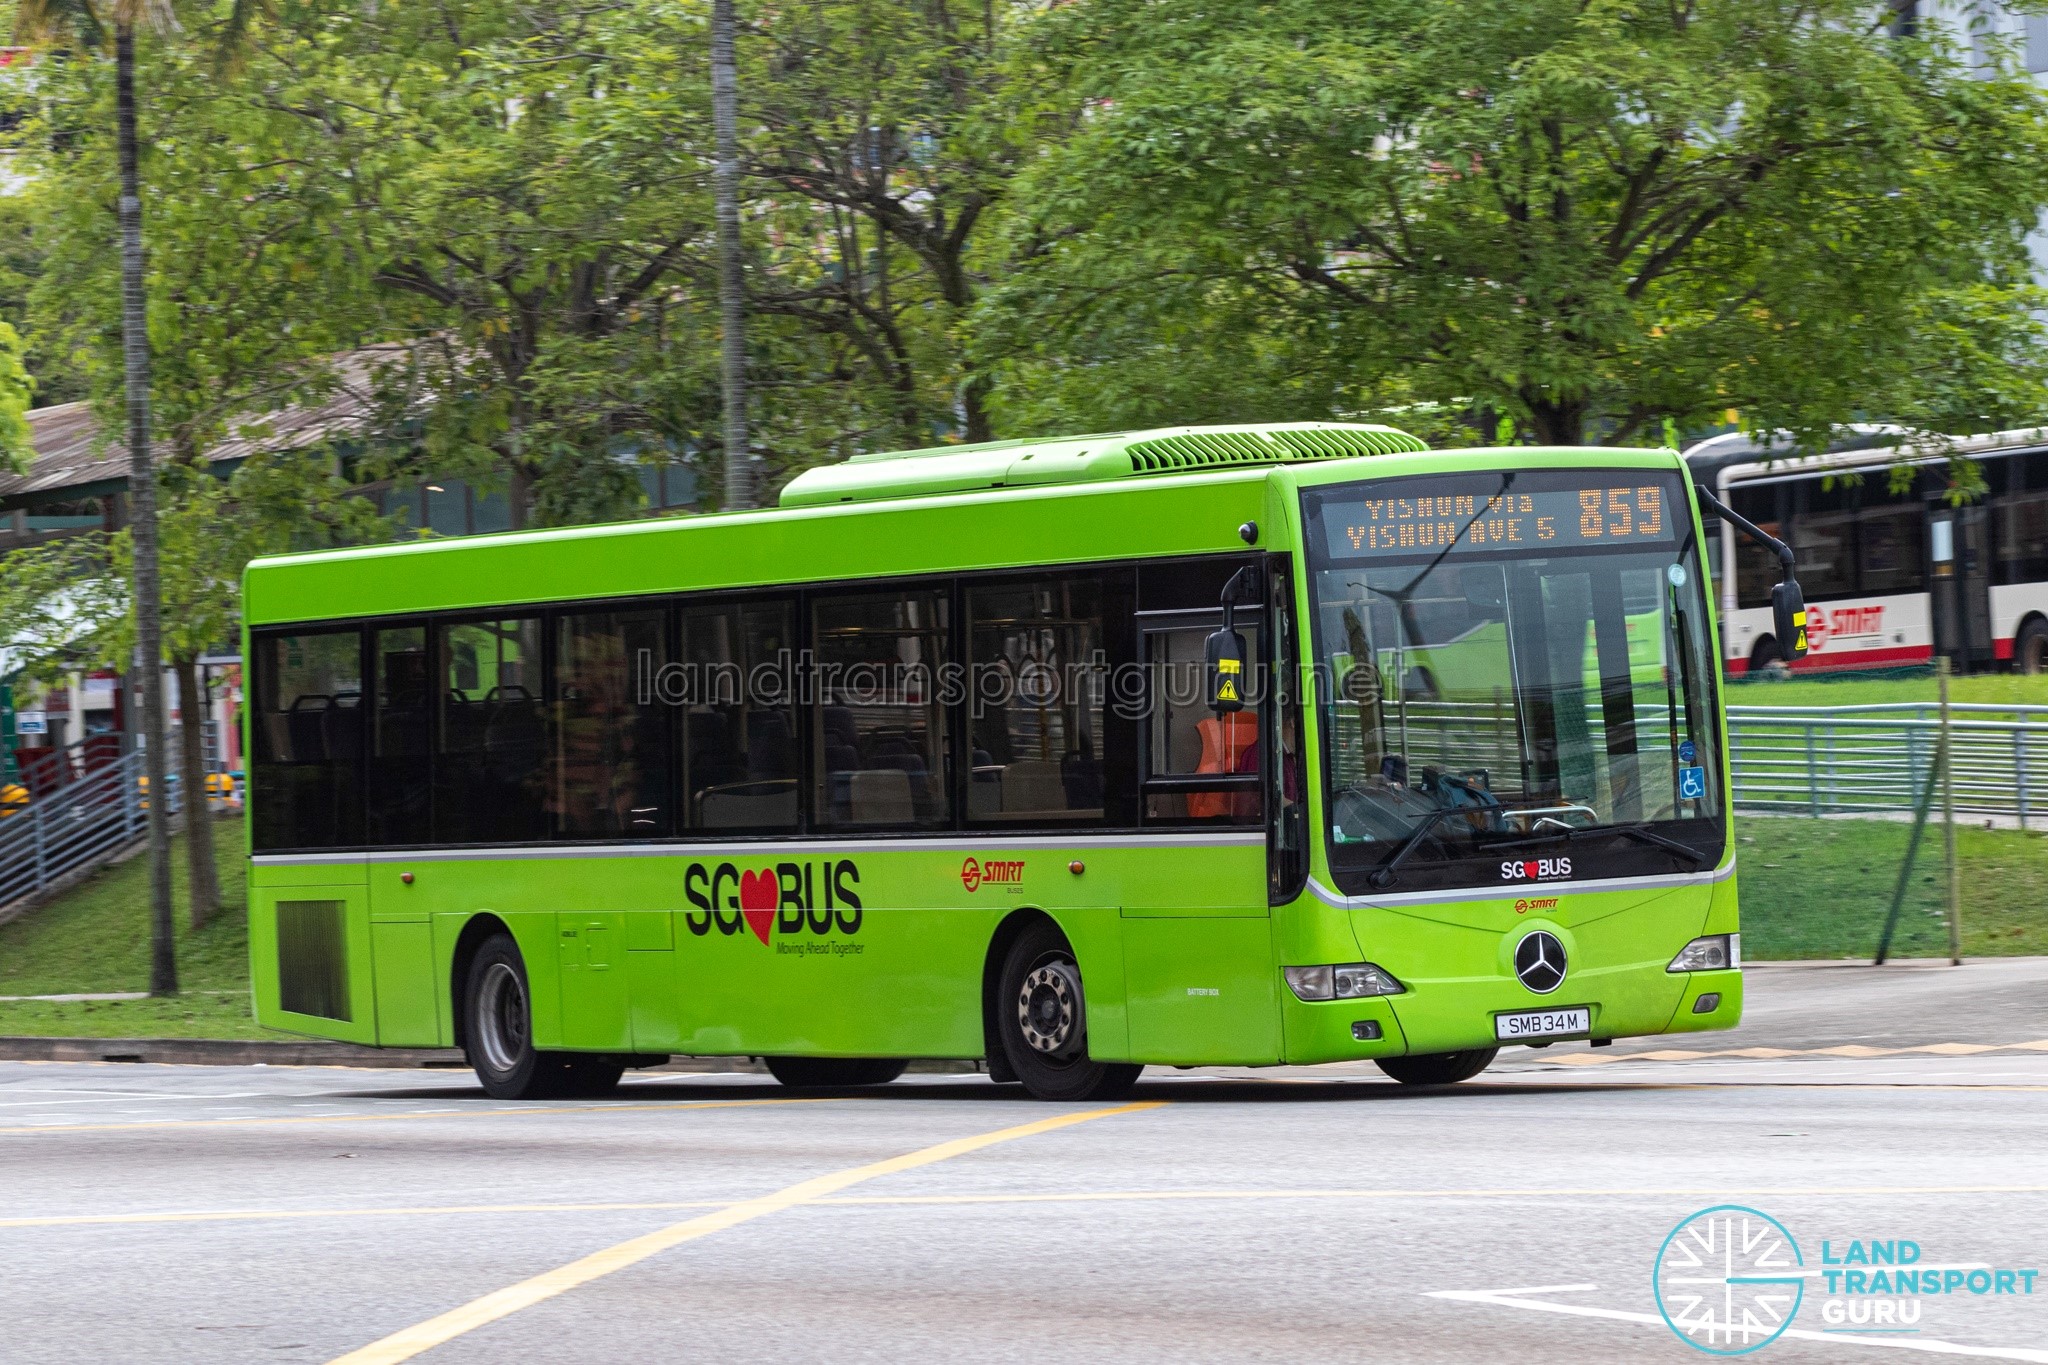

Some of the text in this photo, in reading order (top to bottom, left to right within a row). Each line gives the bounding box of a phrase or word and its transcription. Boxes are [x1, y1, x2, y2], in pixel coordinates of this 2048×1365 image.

[1366, 494, 1533, 520] YISHUN via
[1579, 486, 1661, 538] 859
[1347, 517, 1555, 549] YISHUN AVE 5
[982, 861, 1025, 881] SMRT
[1529, 898, 1559, 909] SMRT
[776, 940, 865, 957] Moving Ahead Together
